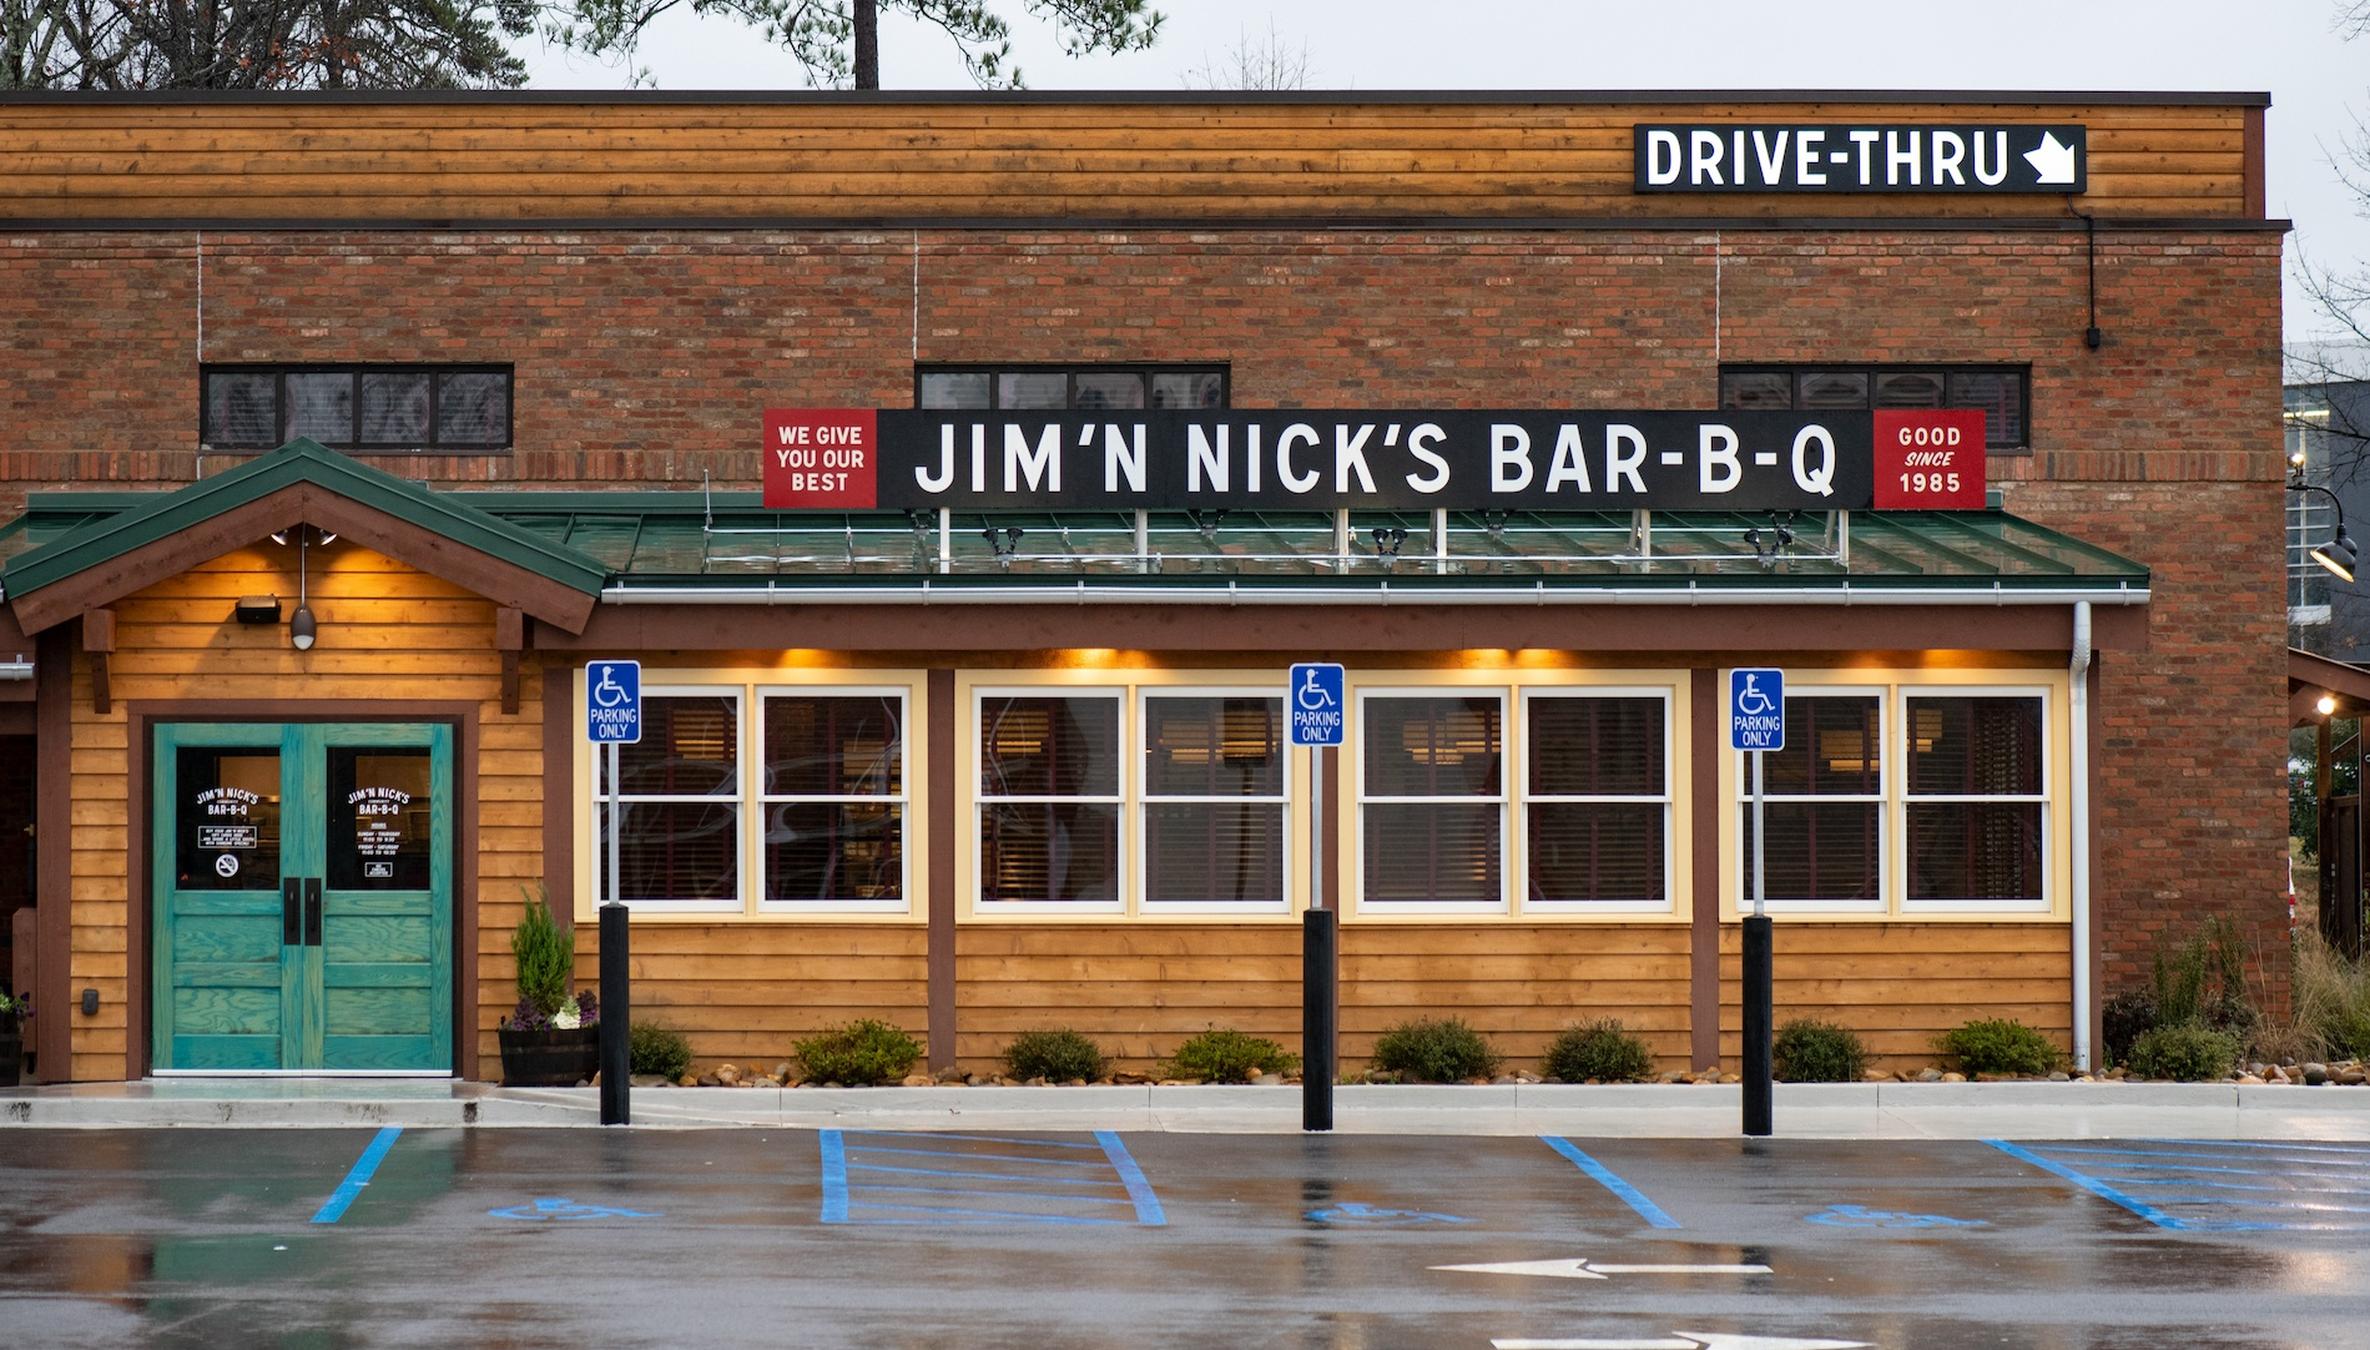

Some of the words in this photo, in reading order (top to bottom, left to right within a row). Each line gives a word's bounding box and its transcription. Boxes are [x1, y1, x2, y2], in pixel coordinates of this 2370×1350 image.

[1646, 129, 2008, 187] DRIVE-THRU
[778, 426, 812, 445] WE
[816, 426, 862, 445] GIVE
[1898, 426, 1962, 447] GOOD
[776, 449, 819, 468] YOU
[823, 449, 865, 468] OUR
[914, 423, 1147, 494] JIM'N
[1187, 423, 1451, 494] NICK'S
[1490, 423, 1837, 498] BAR-B-Q
[1904, 451, 1953, 467] SINCE
[791, 472, 848, 491] BEST
[1899, 473, 1961, 492] 1985
[590, 708, 637, 723] PARKING
[1294, 711, 1341, 726] PARKING
[1734, 716, 1781, 731] PARKING
[598, 724, 628, 739] ONLY
[1302, 727, 1332, 742] ONLY
[1742, 732, 1772, 747] ONLY
[197, 788, 224, 805] JIM'N
[226, 787, 259, 805] NICK'S
[348, 787, 376, 804] JIM'N
[377, 787, 410, 804] NICK'S
[207, 804, 248, 815] BAR-B-Q
[359, 804, 399, 815] BAR-B-Q
